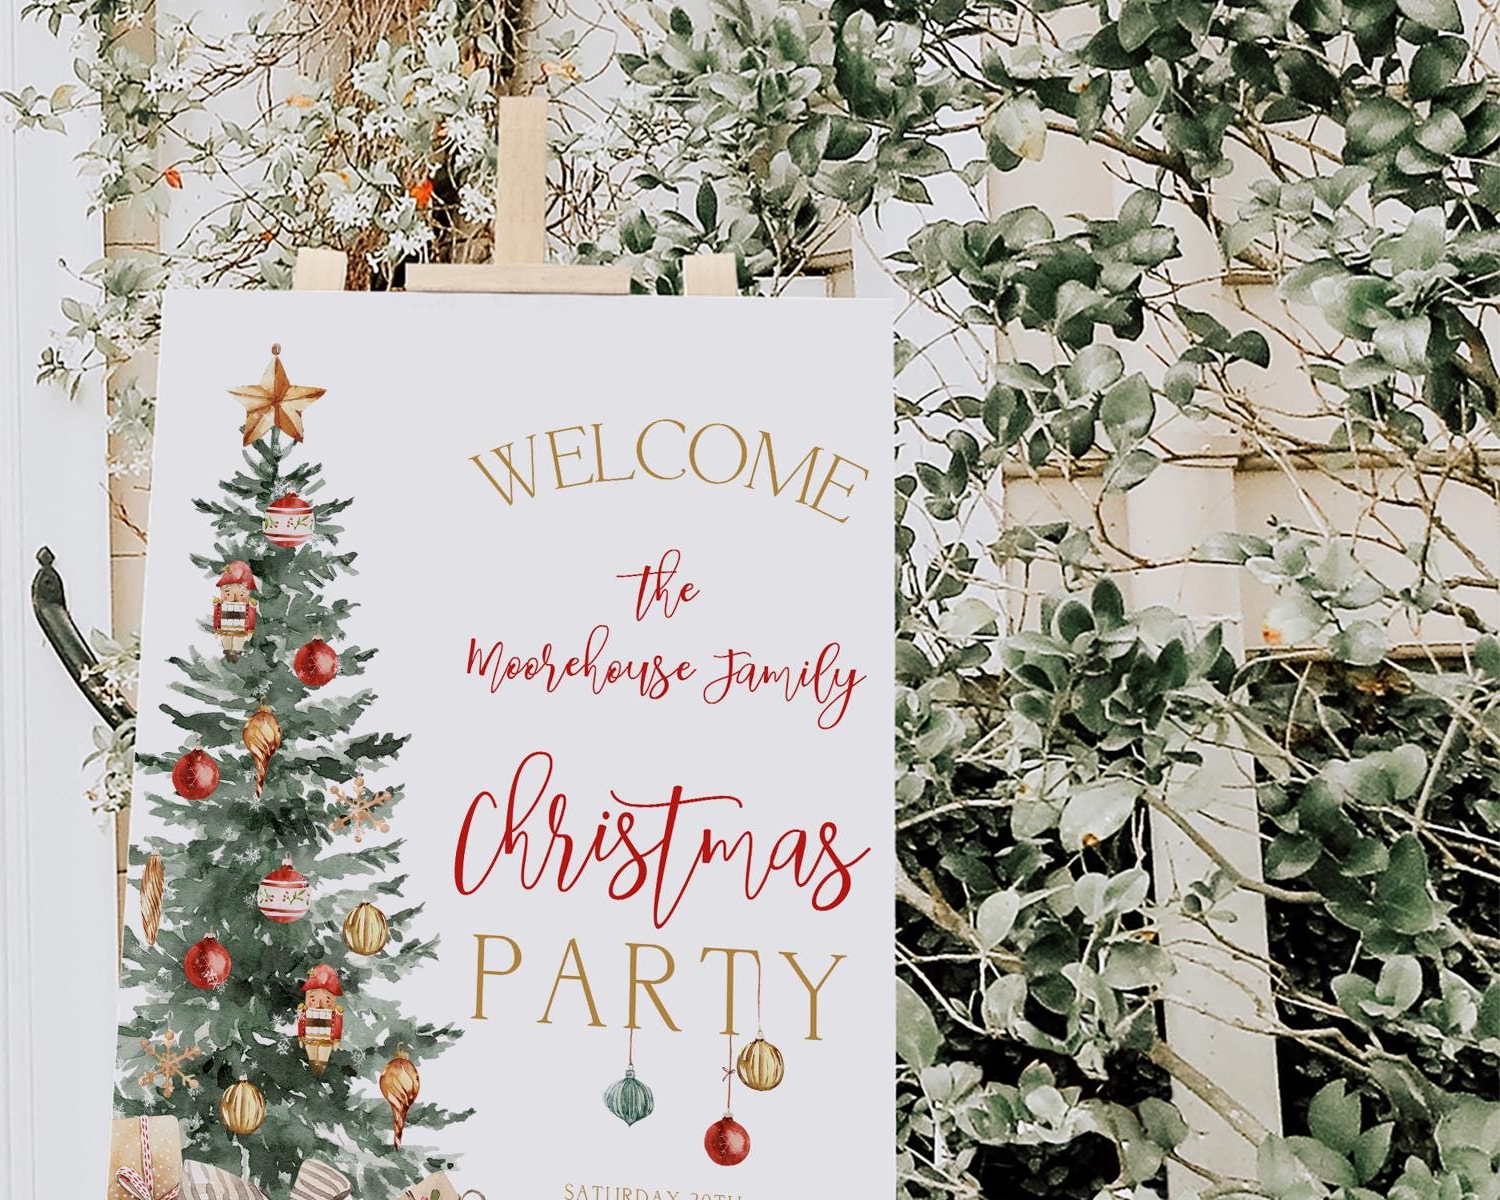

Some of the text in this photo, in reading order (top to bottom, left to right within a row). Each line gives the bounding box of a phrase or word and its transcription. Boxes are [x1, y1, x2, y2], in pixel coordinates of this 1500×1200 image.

[467, 418, 869, 523] WELCOME
[615, 548, 700, 621] the
[465, 624, 867, 730] Moorehouse Family
[453, 751, 871, 929] Christmas
[470, 933, 848, 1041] PARTY
